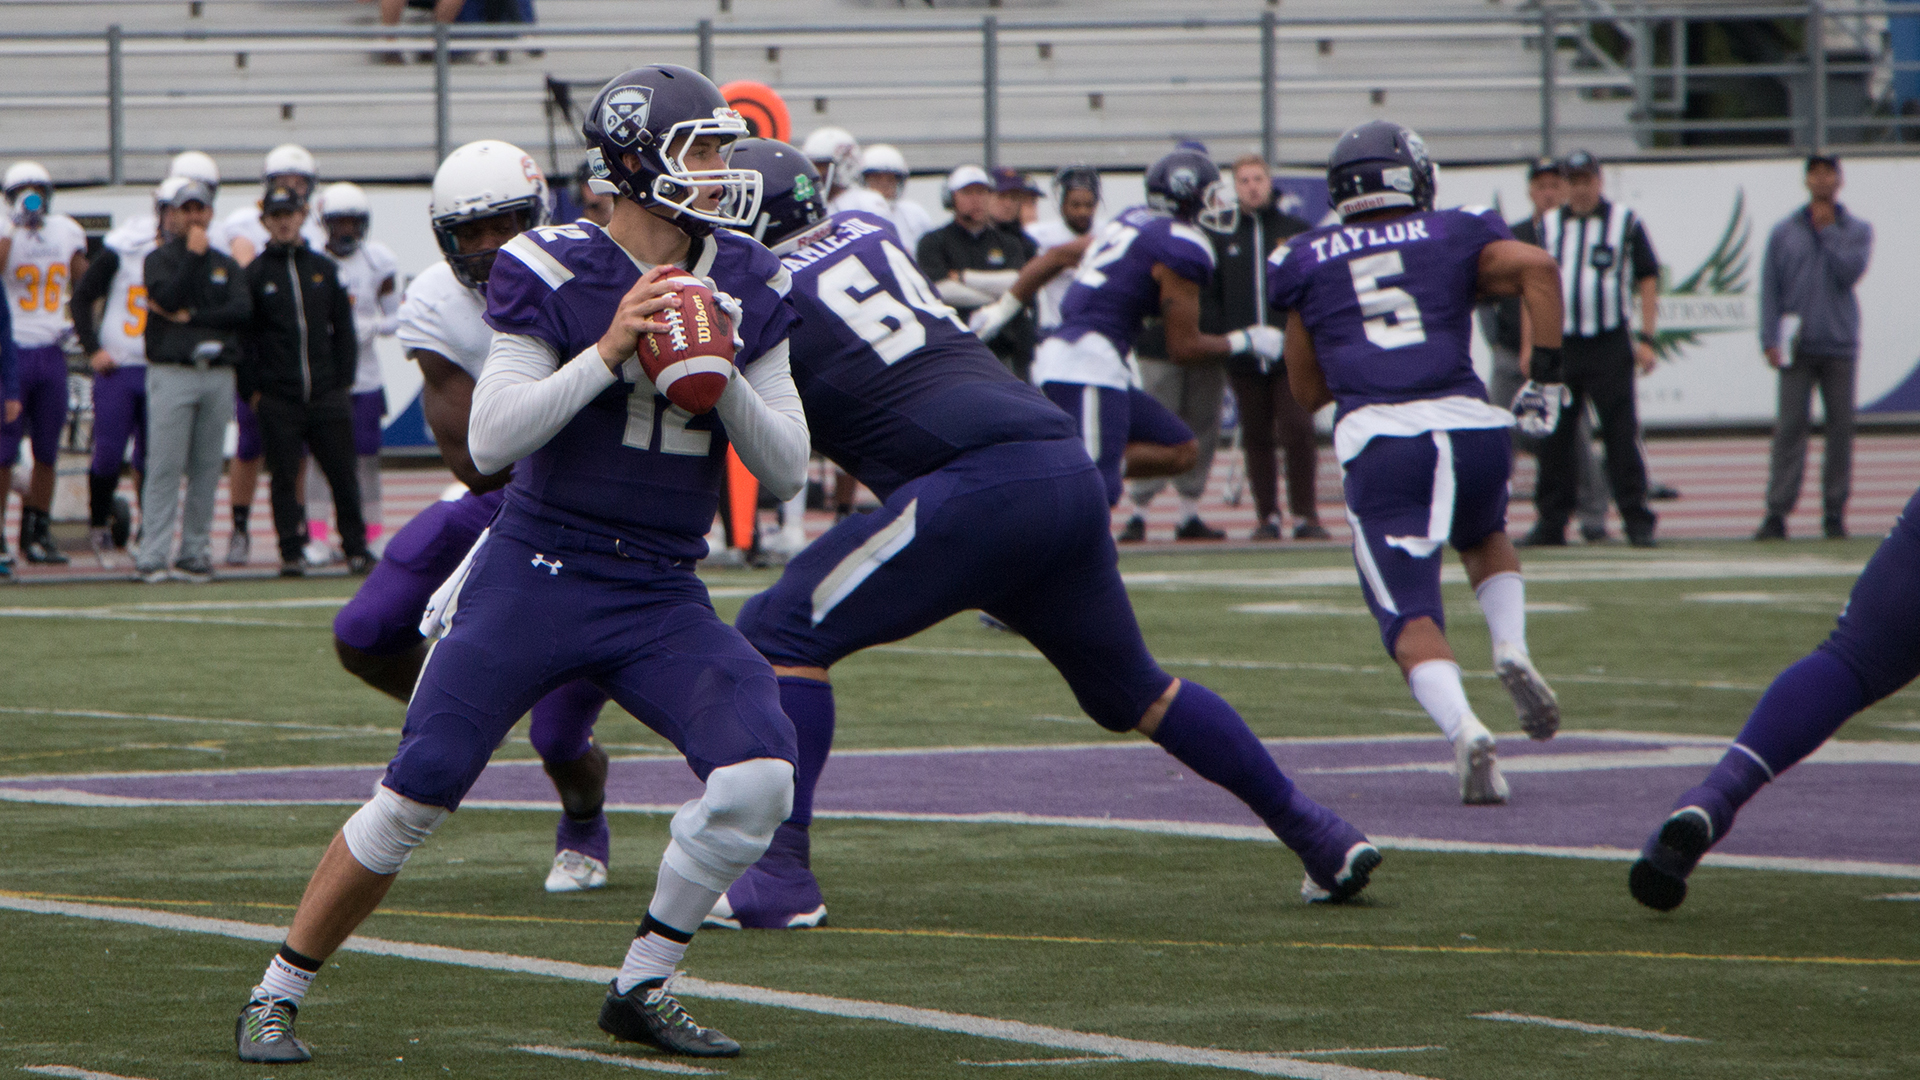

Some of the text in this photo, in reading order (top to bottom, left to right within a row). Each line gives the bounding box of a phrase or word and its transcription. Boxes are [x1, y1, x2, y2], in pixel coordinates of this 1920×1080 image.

[1310, 219, 1430, 264] TAYLOR
[15, 262, 68, 312] 36
[691, 291, 712, 344] Wilson
[817, 240, 973, 366] 64
[1348, 250, 1428, 350] 5
[621, 352, 712, 456] 12
